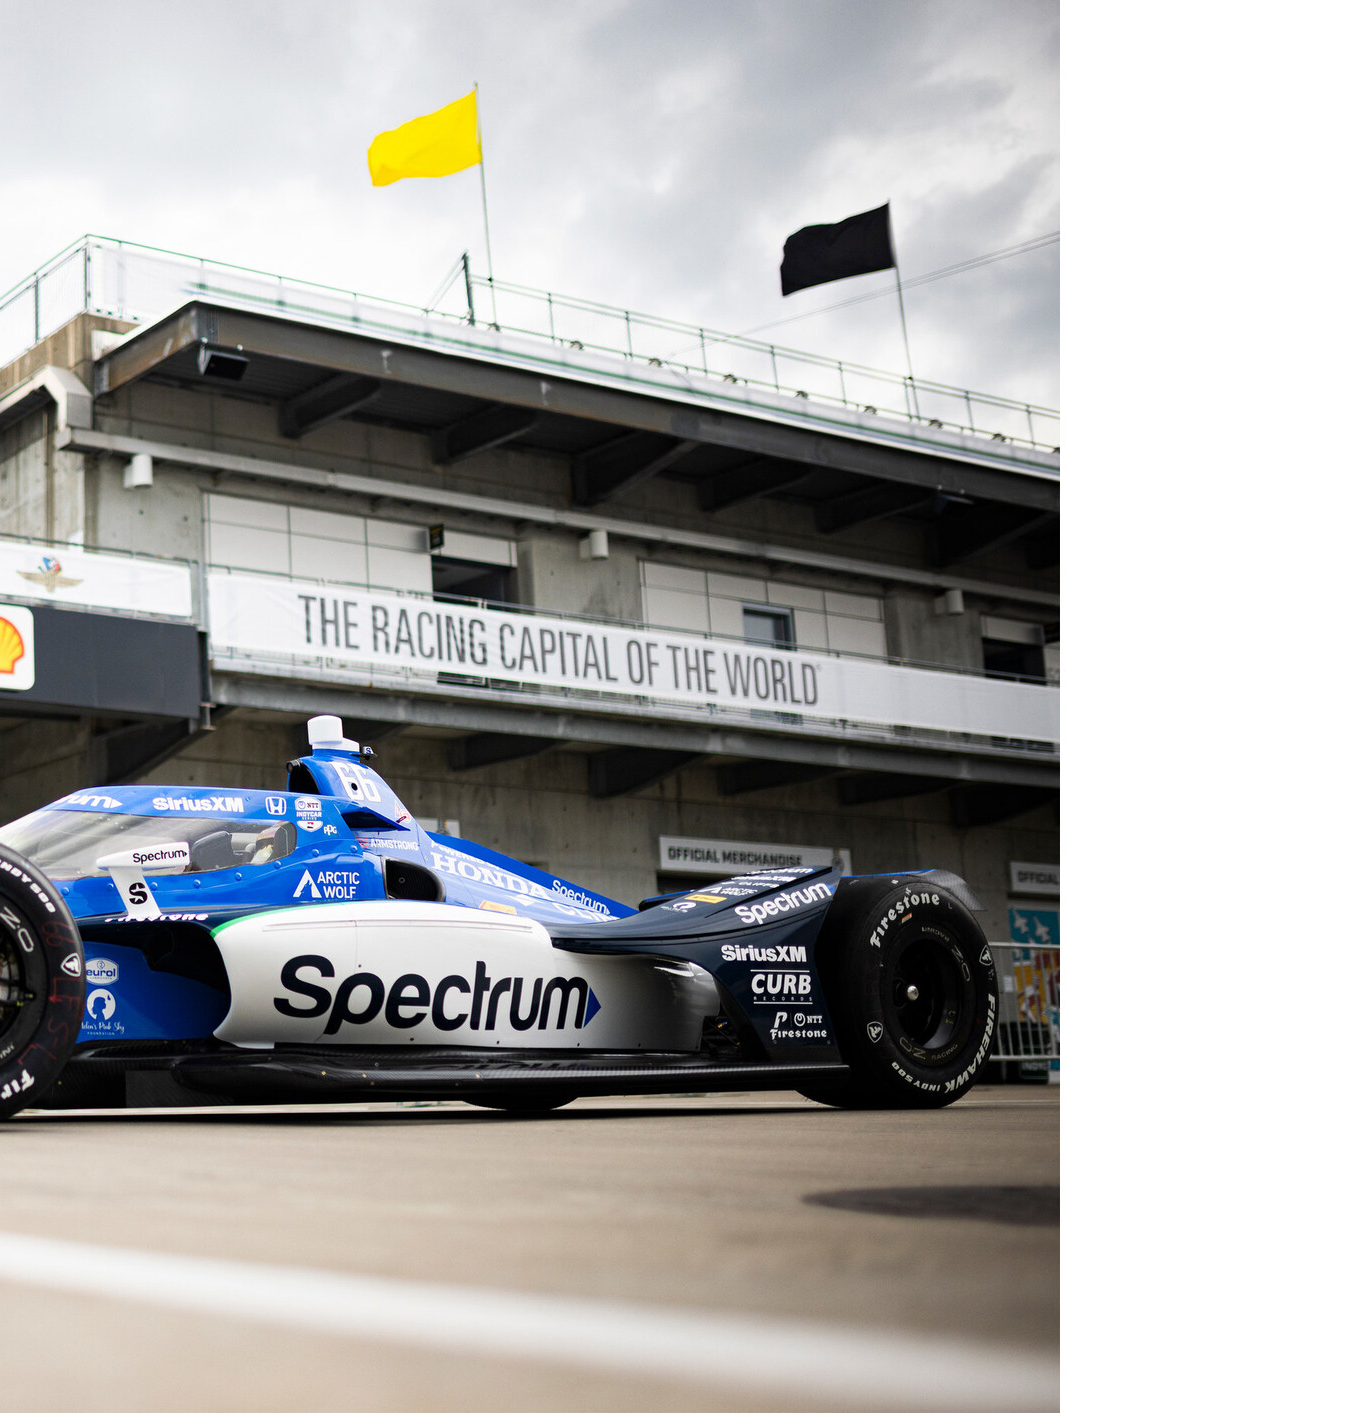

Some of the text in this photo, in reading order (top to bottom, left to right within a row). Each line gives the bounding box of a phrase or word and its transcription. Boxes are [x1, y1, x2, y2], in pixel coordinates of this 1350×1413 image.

[298, 595, 359, 649] THE
[373, 605, 486, 666] RACING
[500, 623, 618, 682] CAPITAL
[627, 639, 659, 686] OF
[666, 645, 716, 695] THE
[328, 761, 382, 803] 66
[152, 797, 244, 812] SiriusXM
[323, 825, 337, 836] PPG
[370, 839, 419, 851] ARMSTRONG
[133, 849, 184, 864] Spectrum
[668, 845, 803, 867] OFFICIAL MERCHANDISE
[317, 872, 360, 884] ARCTIC
[430, 851, 550, 899] HONDA
[323, 886, 356, 898] WOLF
[551, 880, 608, 914] Spectrum
[734, 883, 834, 925] Spectrum
[870, 892, 940, 948] Firestone
[721, 944, 807, 962] SiriusXM
[86, 968, 116, 977] eurol
[751, 973, 812, 995] CURB
[274, 954, 591, 1035] Spectrum
[113, 1021, 125, 1034] Sky
[807, 1015, 823, 1024] NTT
[769, 1028, 828, 1040] Firestone
[944, 993, 996, 1094] FIREHAWK
